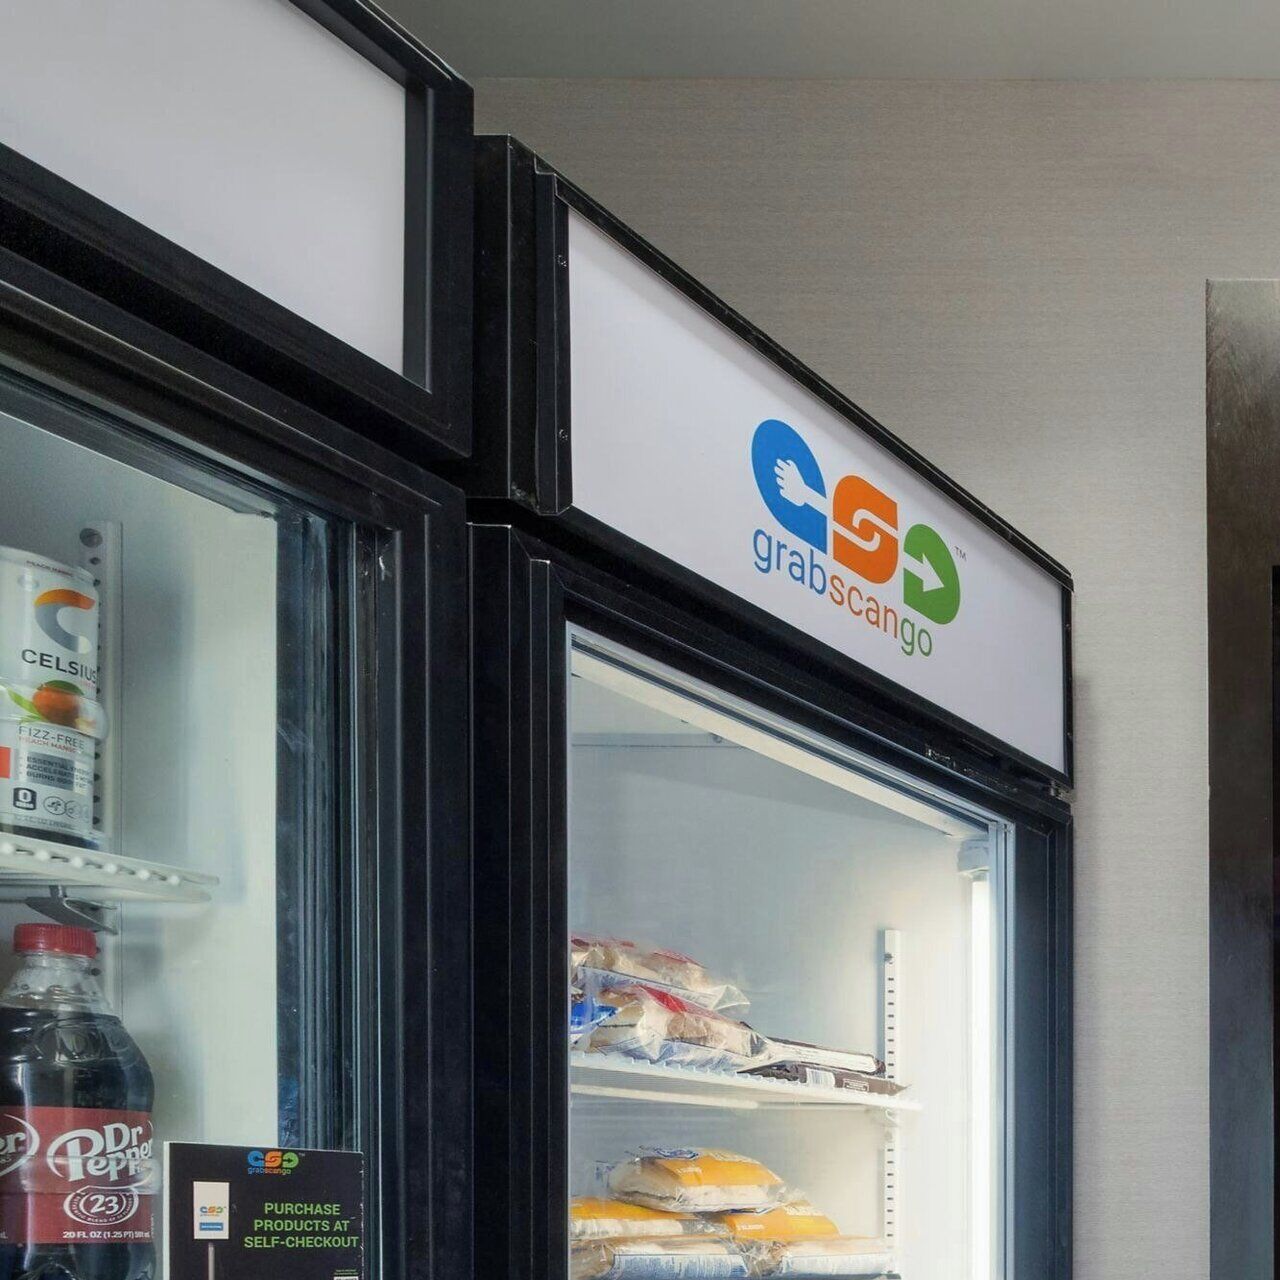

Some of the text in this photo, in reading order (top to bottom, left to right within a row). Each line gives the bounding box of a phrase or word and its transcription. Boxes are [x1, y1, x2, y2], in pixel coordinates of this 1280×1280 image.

[752, 528, 933, 658] grabscango
[103, 1122, 143, 1153] Dr
[47, 1128, 153, 1182] Pepper
[89, 1194, 120, 1216] 23
[264, 1202, 341, 1216] PURCHASE
[90, 1230, 102, 1239] OZ
[253, 1219, 350, 1233] PRODUCTS AT
[243, 1235, 360, 1250] SELF-CHECKOUT
